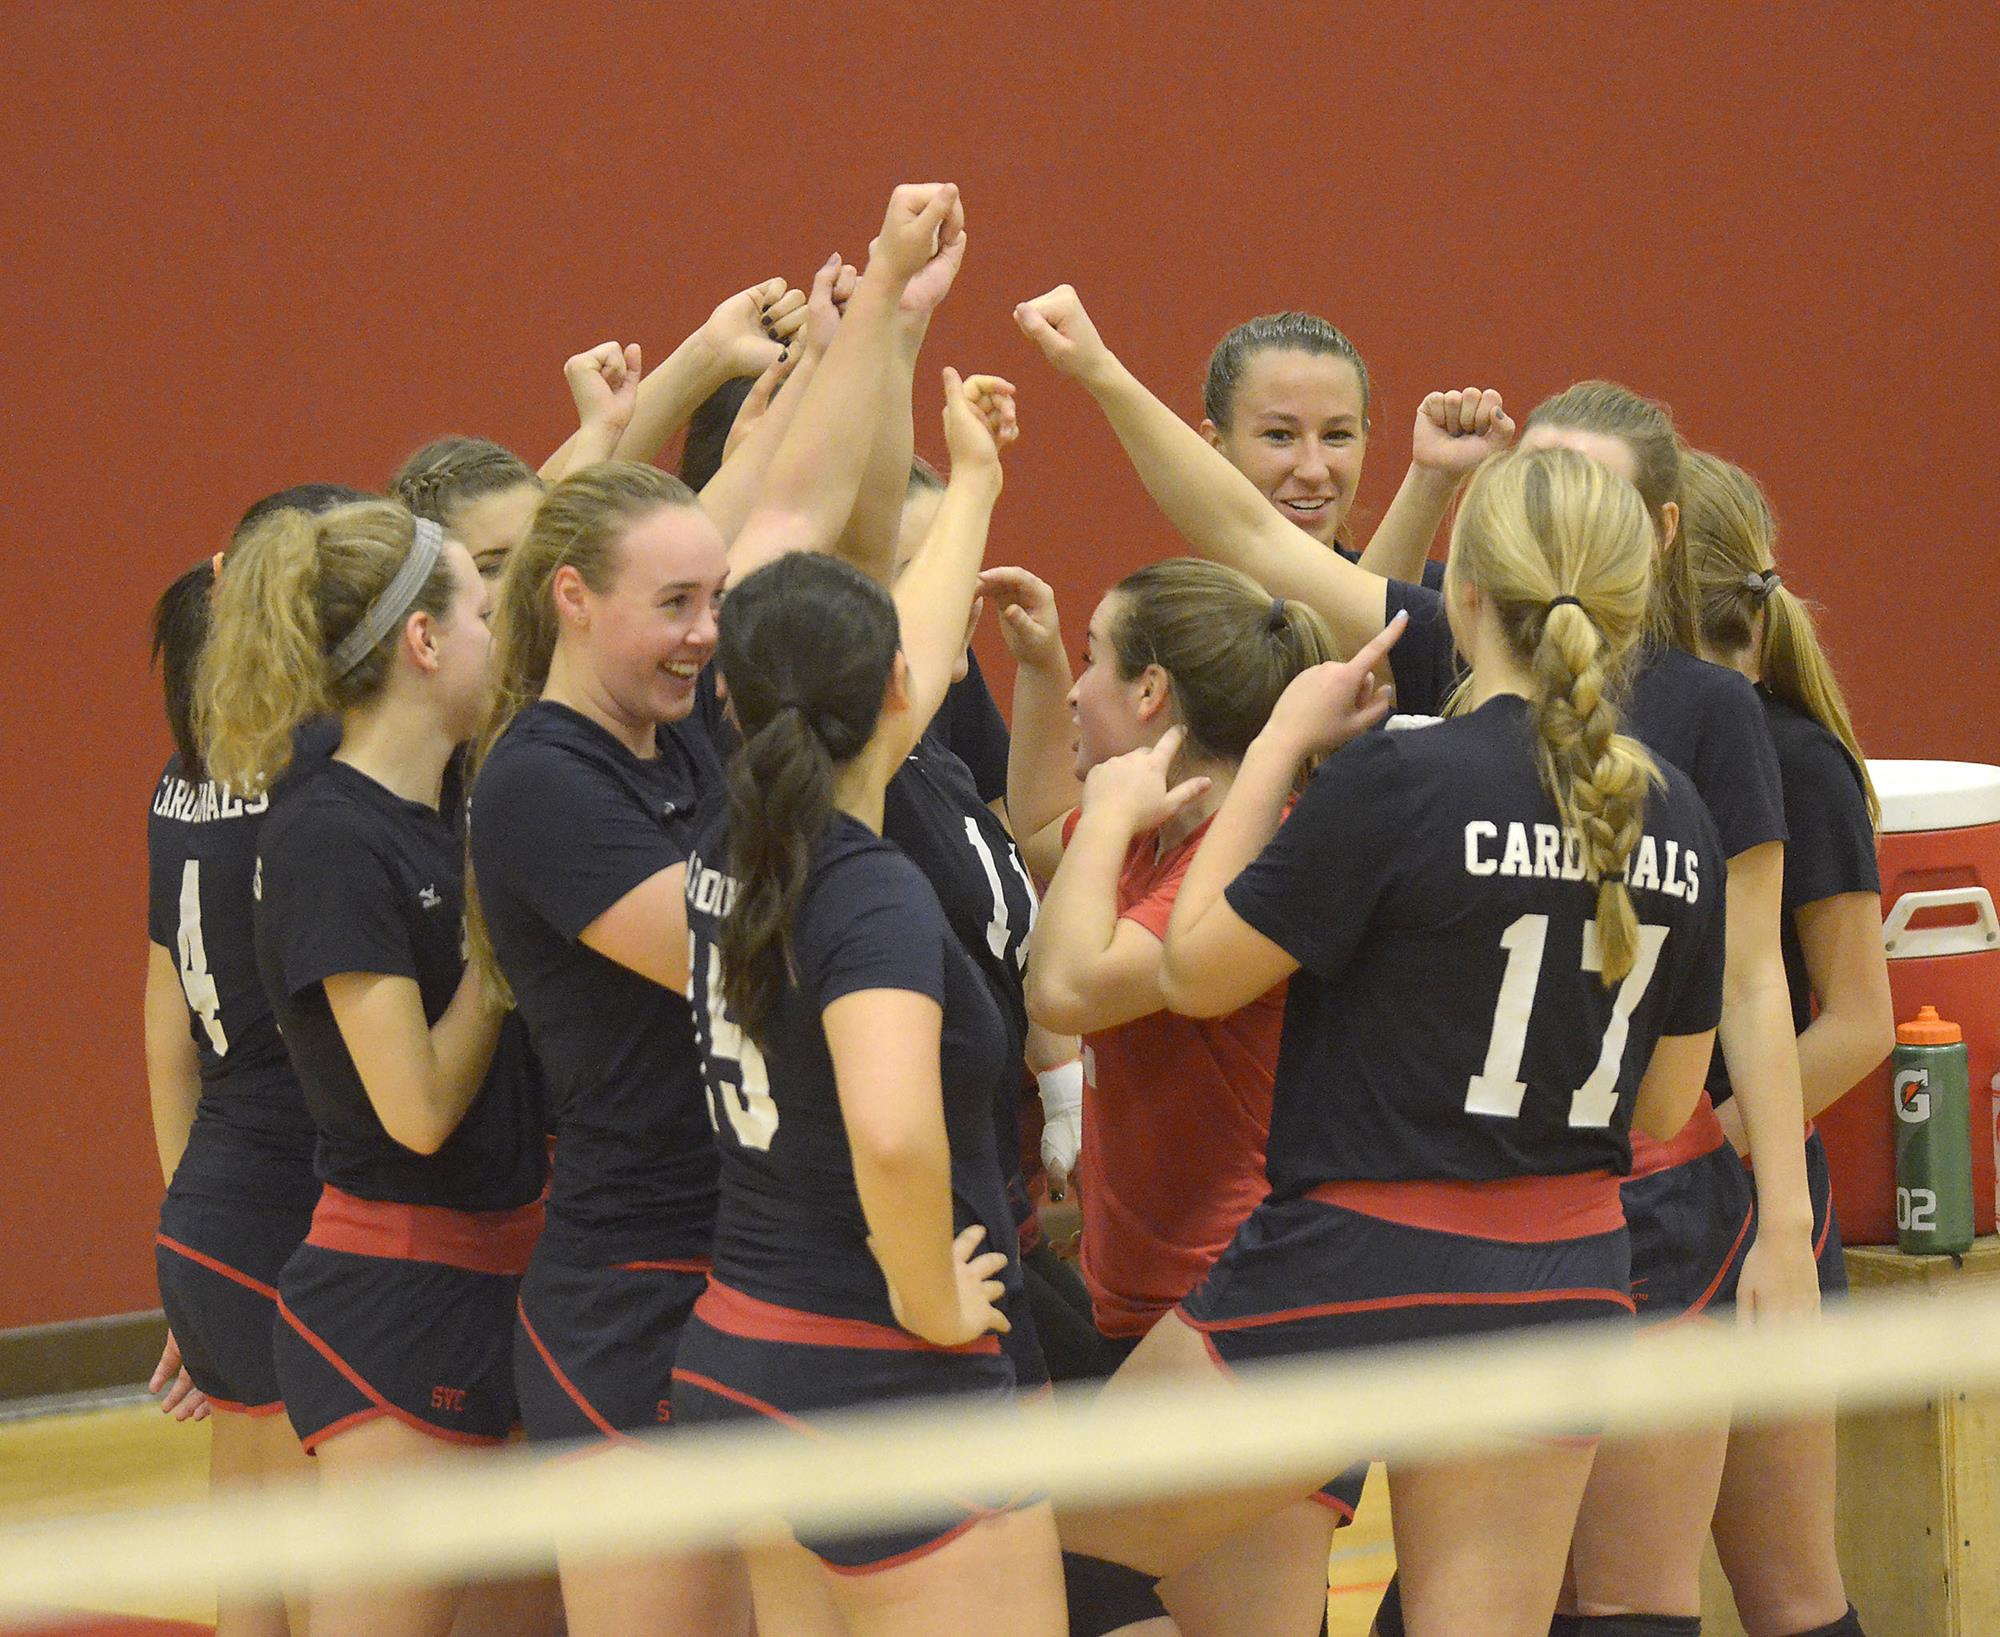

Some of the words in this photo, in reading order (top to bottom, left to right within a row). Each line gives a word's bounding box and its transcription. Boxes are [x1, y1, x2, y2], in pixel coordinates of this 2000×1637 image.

[1464, 820, 1699, 905] CARDALS
[177, 859, 229, 1058] 4
[1464, 913, 1671, 1128] 17
[1894, 1068, 1931, 1124] G
[1896, 1186, 1937, 1231] 02
